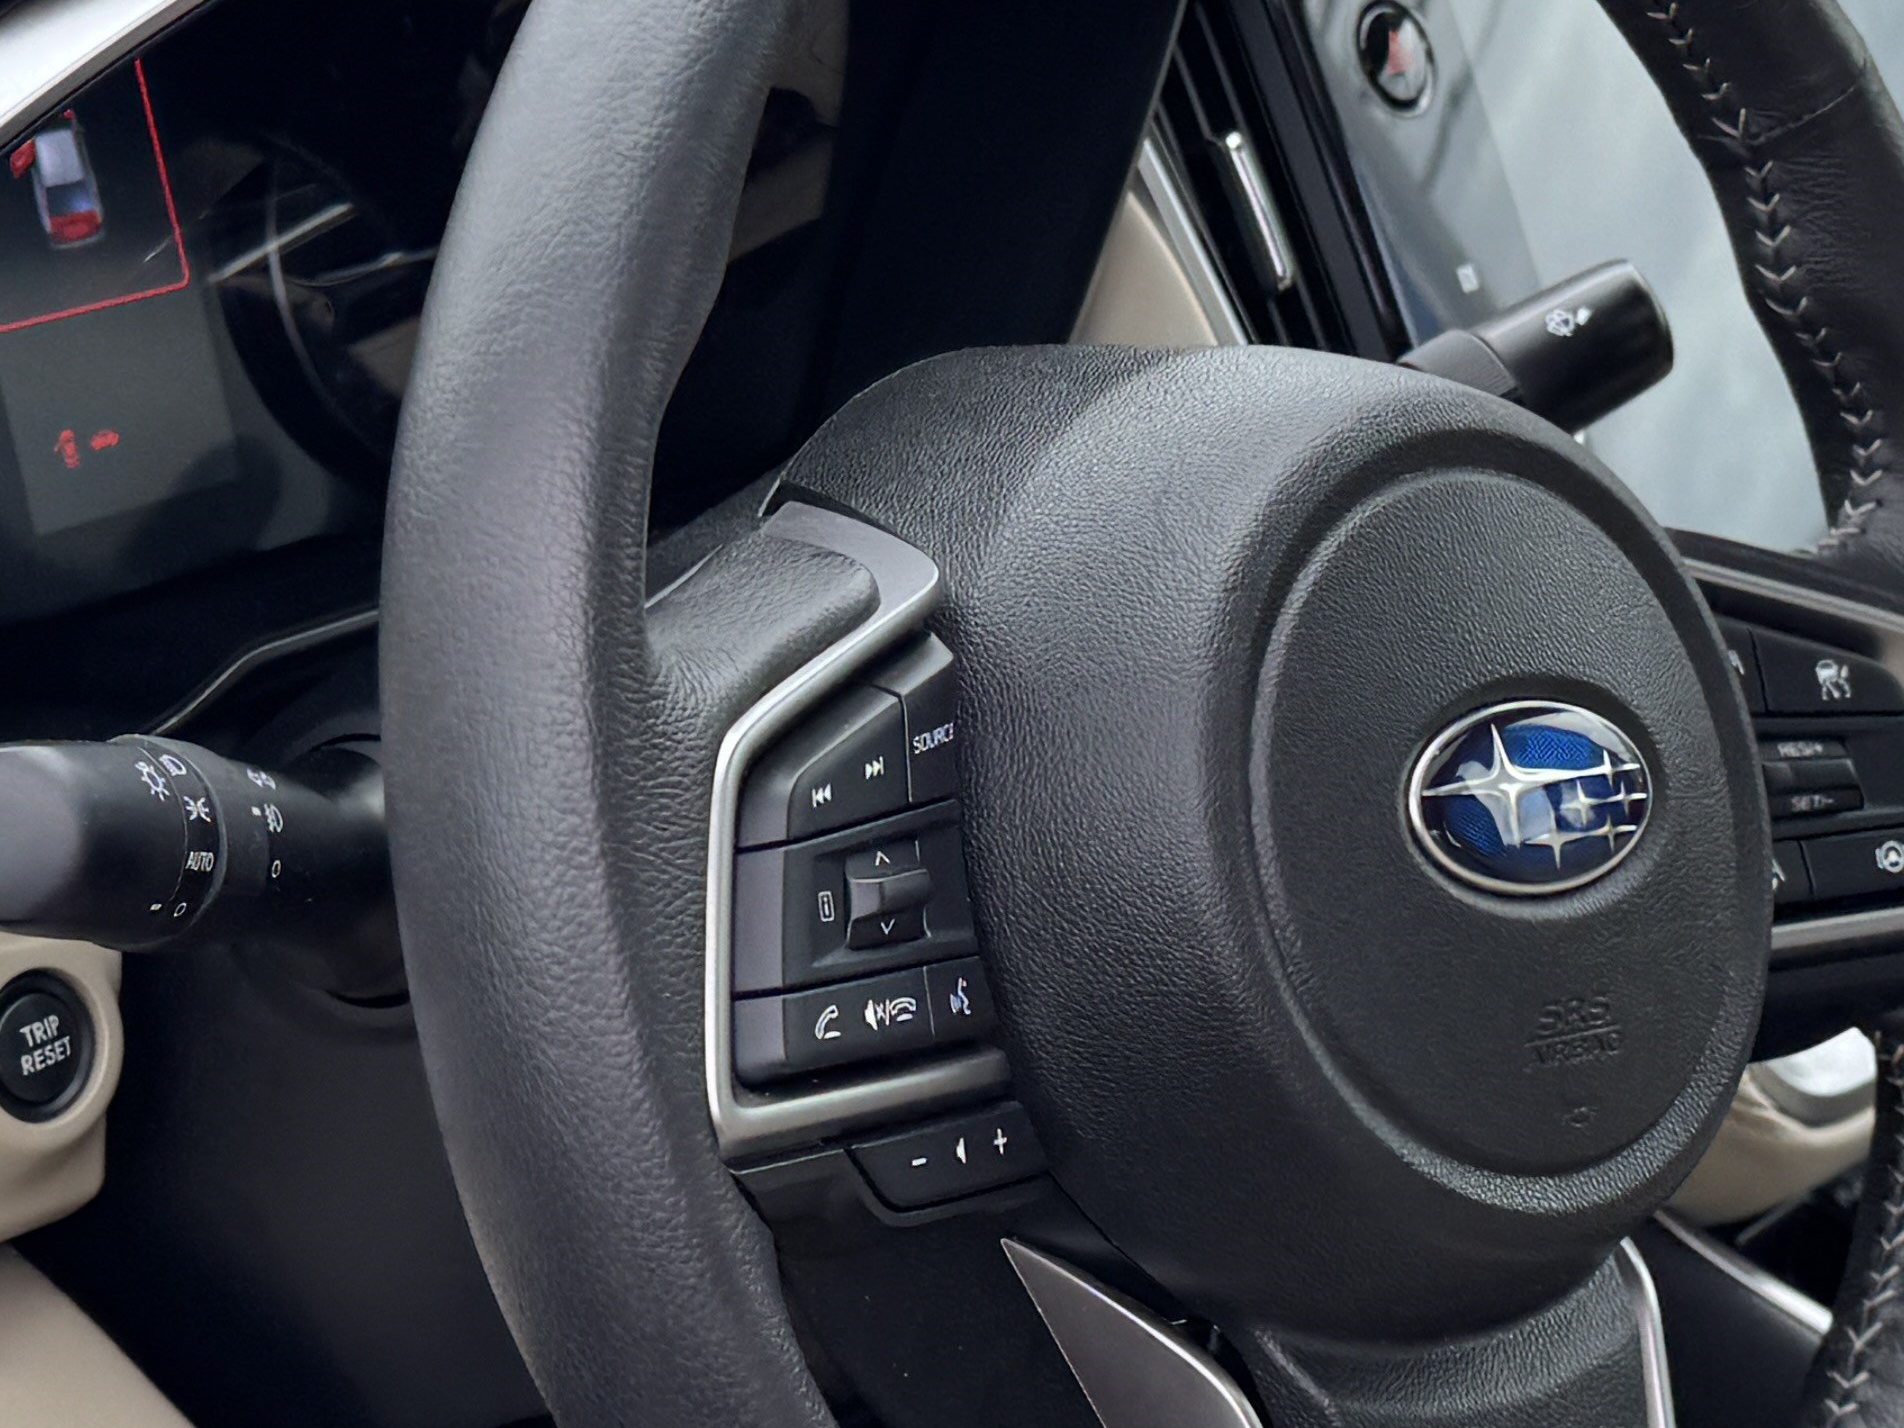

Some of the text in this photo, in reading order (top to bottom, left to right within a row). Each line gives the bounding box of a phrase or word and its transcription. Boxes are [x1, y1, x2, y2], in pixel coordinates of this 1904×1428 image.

[185, 850, 215, 872] AUTO
[19, 1014, 60, 1048] TRIP
[20, 1035, 71, 1076] RESET
